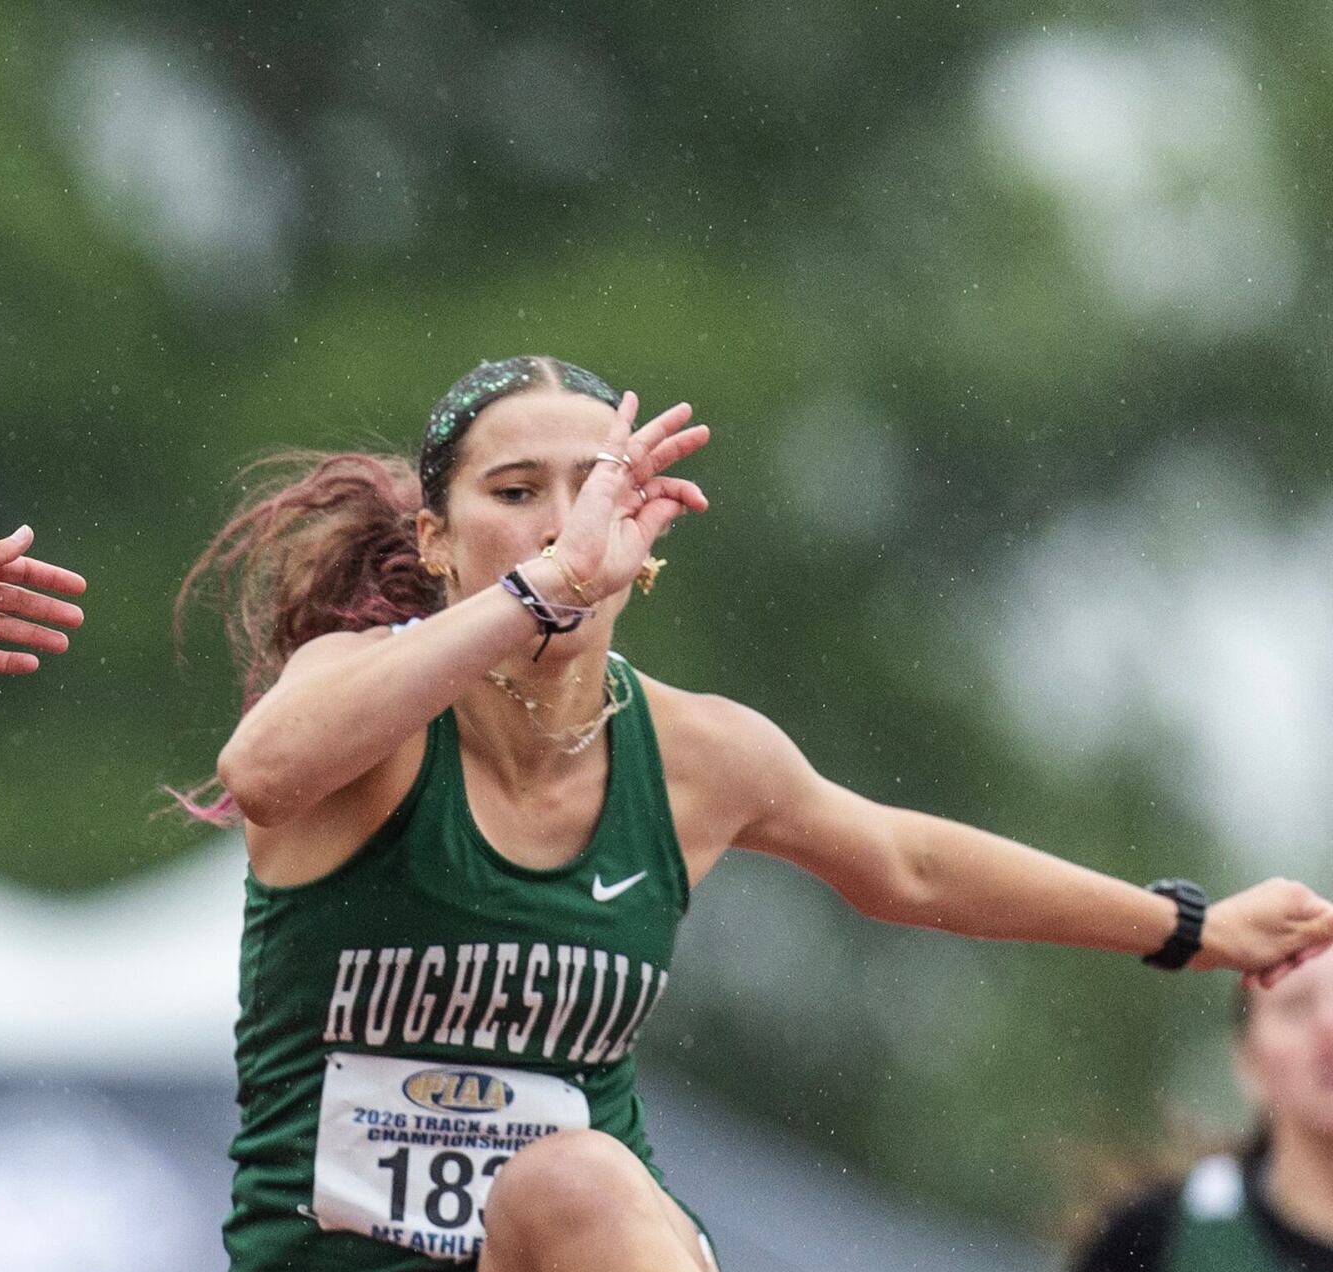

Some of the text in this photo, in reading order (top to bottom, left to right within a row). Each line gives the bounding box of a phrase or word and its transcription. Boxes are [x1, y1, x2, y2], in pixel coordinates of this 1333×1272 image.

[412, 1071, 508, 1110] PIAA
[353, 1107, 407, 1127] 2026
[413, 1115, 481, 1134] TRACK
[486, 1123, 499, 1136] &
[367, 1128, 534, 1151] CHAMPIONSHIP
